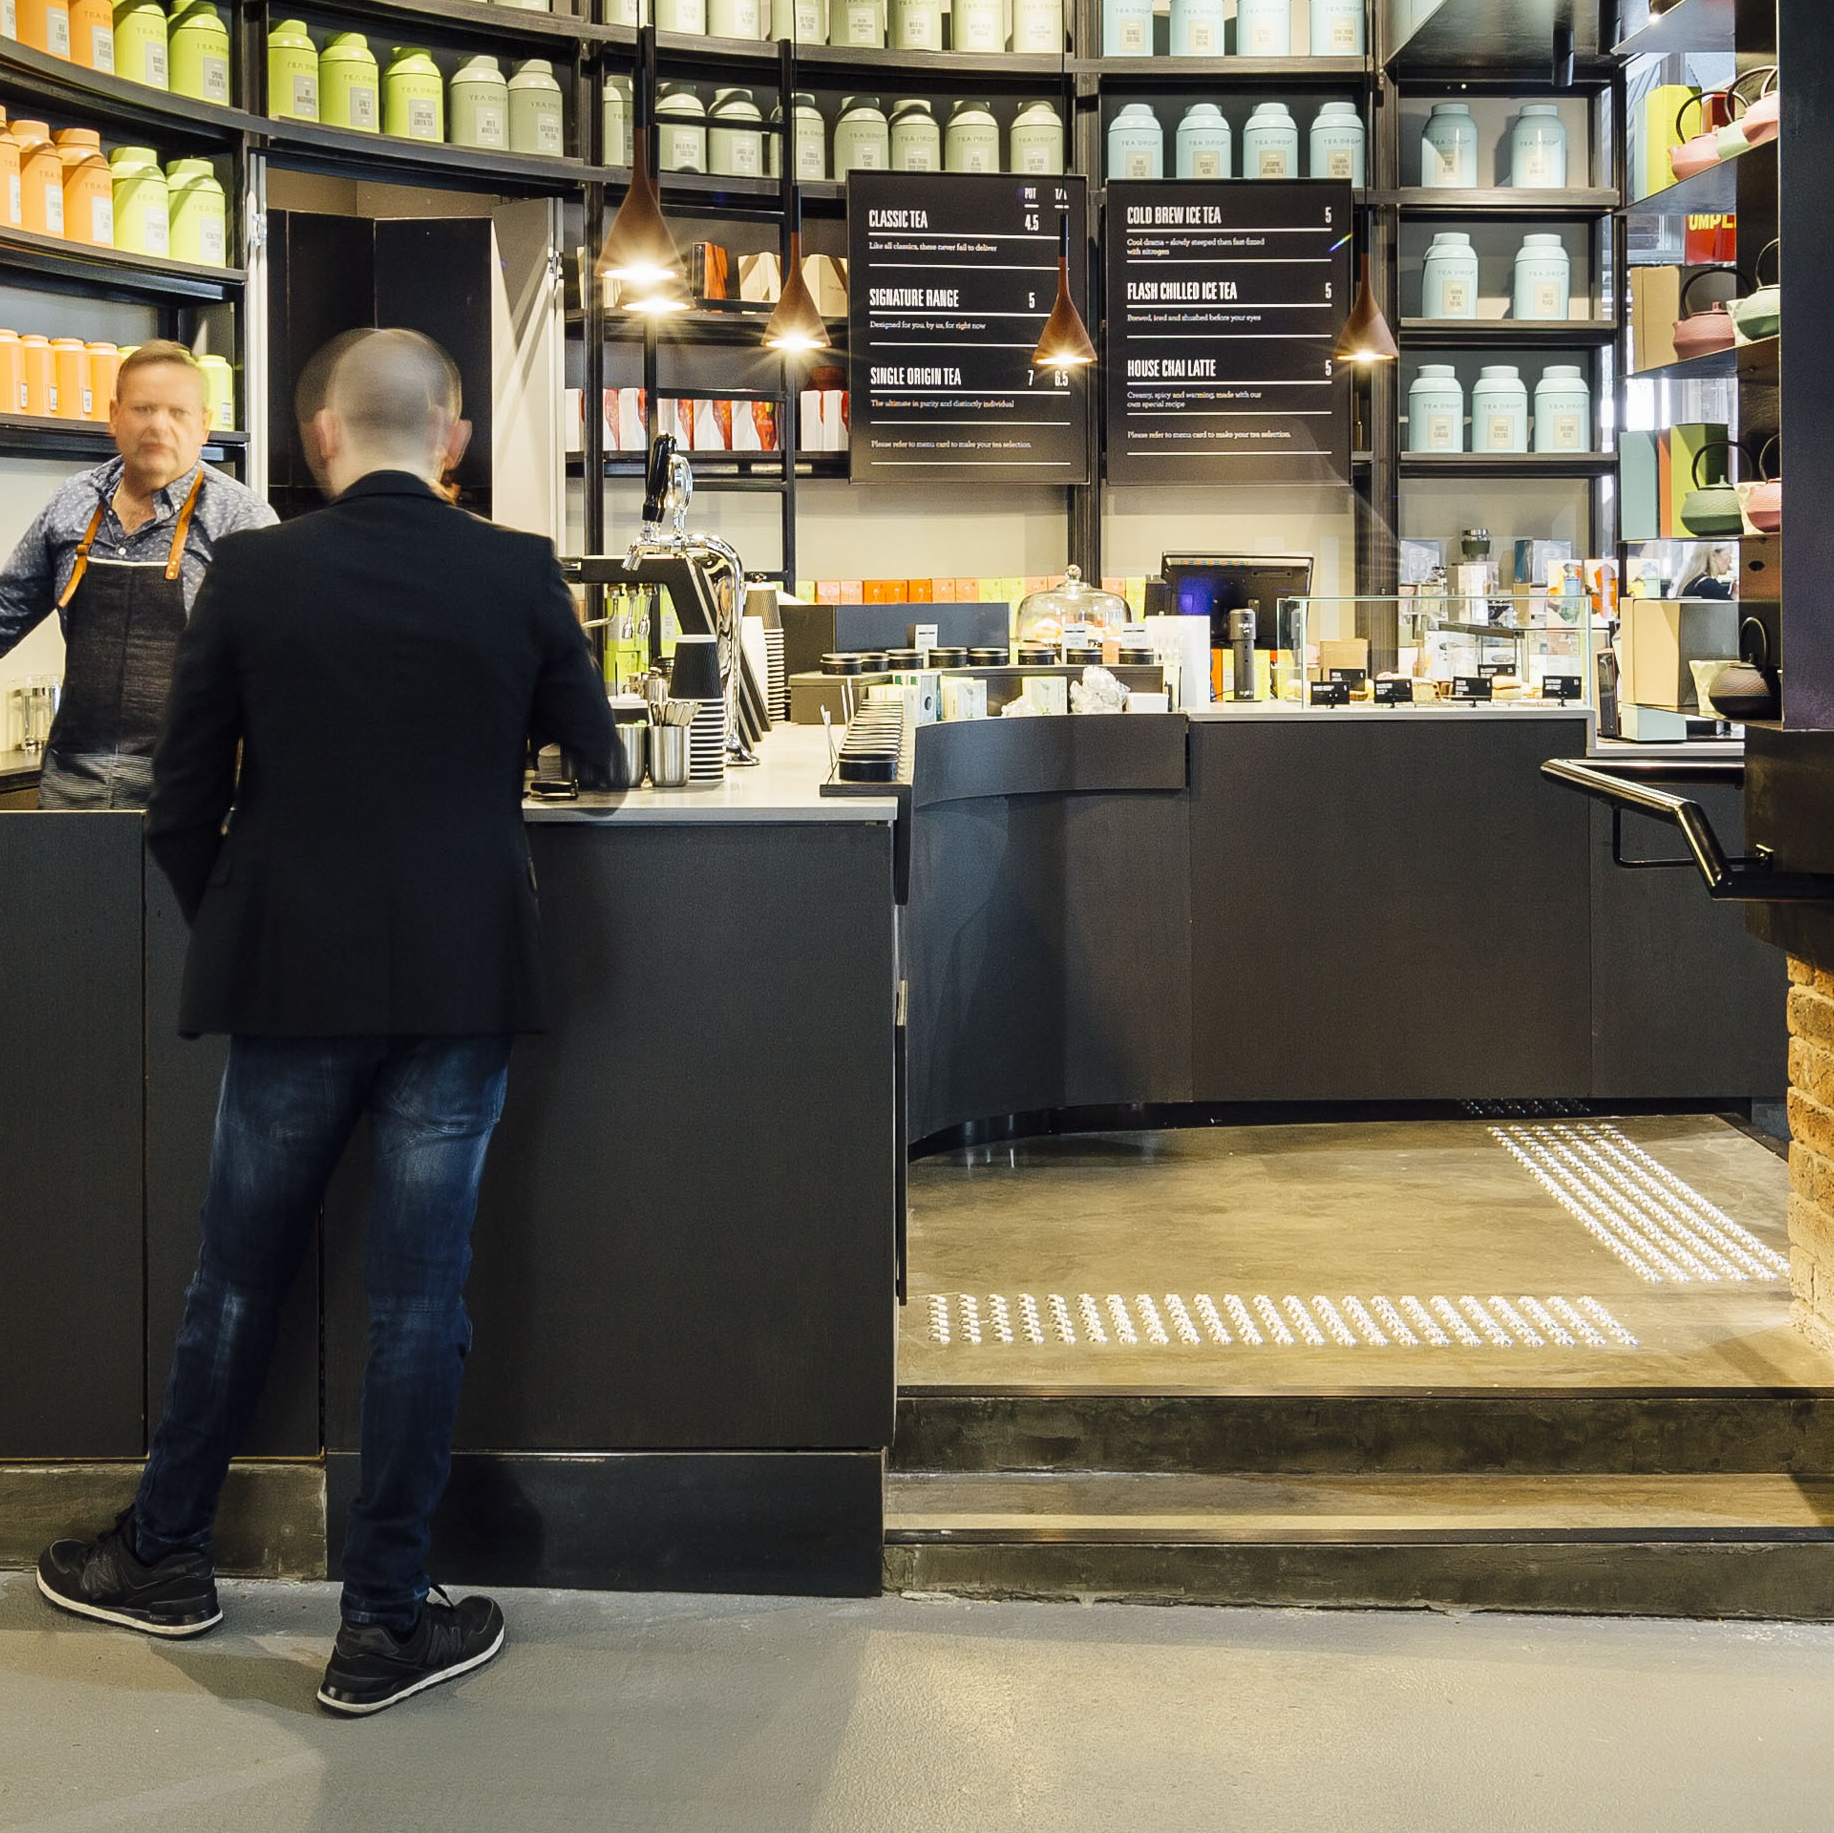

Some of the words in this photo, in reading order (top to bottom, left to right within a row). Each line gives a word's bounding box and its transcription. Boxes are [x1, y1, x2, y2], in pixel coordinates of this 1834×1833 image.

[1024, 187, 1037, 200] POT
[868, 210, 909, 229] CLASSIC
[910, 210, 929, 229] TEA
[1024, 214, 1040, 232] 4.5
[1126, 206, 1154, 225] COLD
[1154, 206, 1184, 225] BREW
[1185, 206, 1201, 225] ICE
[1202, 206, 1222, 225] TEA
[1324, 206, 1332, 224] 5
[868, 241, 884, 250] Like
[884, 241, 893, 250] all
[937, 244, 956, 252] never
[955, 242, 967, 252] fail
[967, 243, 974, 252] to
[974, 242, 998, 253] deliver
[1126, 238, 1143, 247] Cool
[1143, 238, 1165, 247] drama
[1169, 237, 1191, 247] slowly
[1191, 238, 1217, 247] steeped
[1217, 237, 1233, 247] then
[1126, 248, 1141, 256] with
[1141, 247, 1170, 257] nitrogen
[1126, 282, 1158, 301] FLASH
[1160, 281, 1200, 301] CHILLED
[1201, 281, 1218, 300] ICE
[1218, 281, 1238, 300] TEA
[1324, 282, 1332, 300] 5
[869, 288, 924, 308] SIGNATURE
[925, 289, 960, 308] RANGE
[1028, 292, 1036, 309] 5
[1153, 314, 1168, 322] iced
[1167, 314, 1181, 322] and
[1209, 313, 1230, 322] before
[1230, 314, 1246, 324] your
[1246, 314, 1262, 323] eyes
[870, 320, 901, 330] Designed
[902, 320, 911, 328] for
[926, 321, 934, 330] by
[945, 321, 955, 329] for
[955, 321, 971, 331] right
[1126, 359, 1160, 378] HOUSE
[1161, 359, 1186, 378] CHAI
[1187, 359, 1217, 378] LATTE
[1324, 359, 1332, 377] 5
[870, 366, 906, 386] SINGLE
[907, 367, 942, 386] ORIGIN
[943, 367, 962, 386] TEA
[1027, 370, 1034, 387] 7
[1054, 370, 1069, 388] 6.5
[1154, 391, 1172, 401] spicy
[1172, 391, 1185, 399] and
[1216, 391, 1235, 399] made
[1234, 391, 1250, 399] with
[870, 399, 884, 407] The
[884, 399, 912, 408] ultimate
[912, 399, 920, 408] in
[919, 400, 940, 409] purity
[939, 399, 953, 408] and
[952, 399, 983, 409] distinctly
[982, 399, 1015, 408] individual
[1126, 401, 1141, 409] own
[1141, 400, 1165, 409] special
[1164, 401, 1186, 409] recipe
[1127, 430, 1148, 439] Please
[1148, 430, 1164, 439] refer
[1164, 431, 1173, 439] to
[1172, 431, 1192, 439] menu
[1192, 430, 1208, 439] card
[1207, 431, 1216, 439] to
[1215, 430, 1234, 439] make
[1233, 431, 1250, 440] your
[1249, 431, 1260, 439] tea
[870, 439, 892, 448] Please
[892, 439, 909, 448] refer
[908, 440, 916, 448] to
[916, 440, 935, 448] menu
[935, 439, 951, 448] card
[950, 440, 959, 448] to
[958, 440, 976, 448] make
[976, 440, 991, 449] your
[991, 440, 1002, 448] tea
